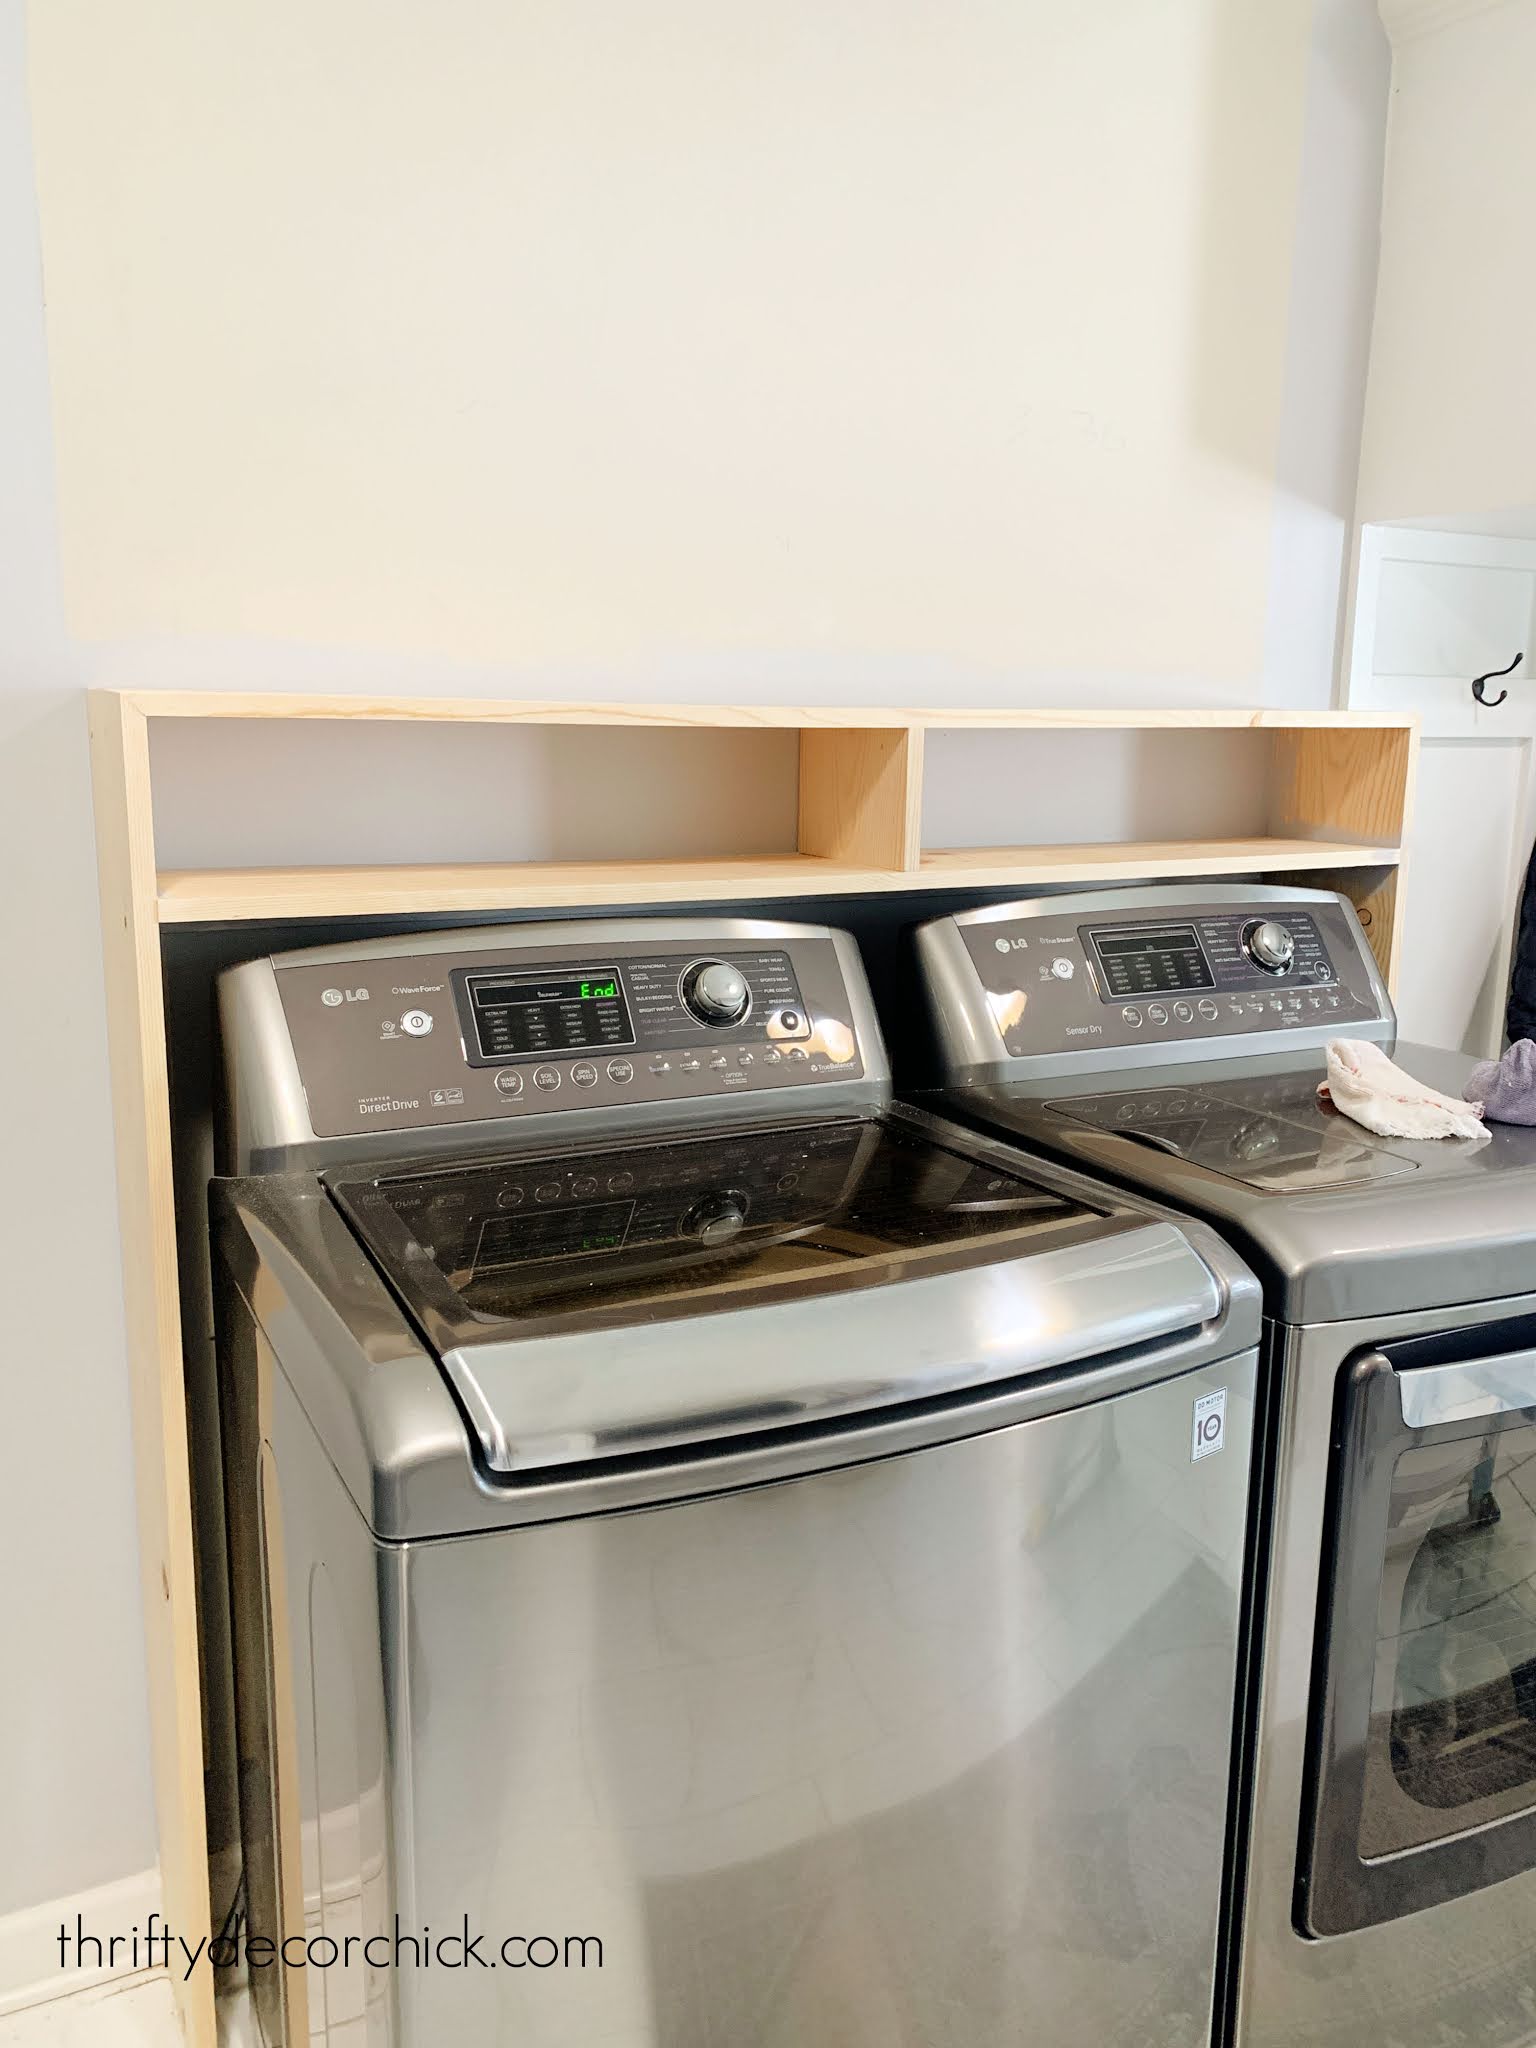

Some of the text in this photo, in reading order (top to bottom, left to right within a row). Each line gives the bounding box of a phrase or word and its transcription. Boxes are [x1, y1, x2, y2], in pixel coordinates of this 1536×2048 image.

[1011, 938, 1028, 950] LG
[345, 988, 370, 1002] LG
[580, 982, 615, 999] End
[1066, 1025, 1102, 1036] Sensor Dry
[359, 1099, 420, 1114] Direct Drive
[1206, 1394, 1223, 1405] MOTOR
[1198, 1414, 1221, 1445] 10
